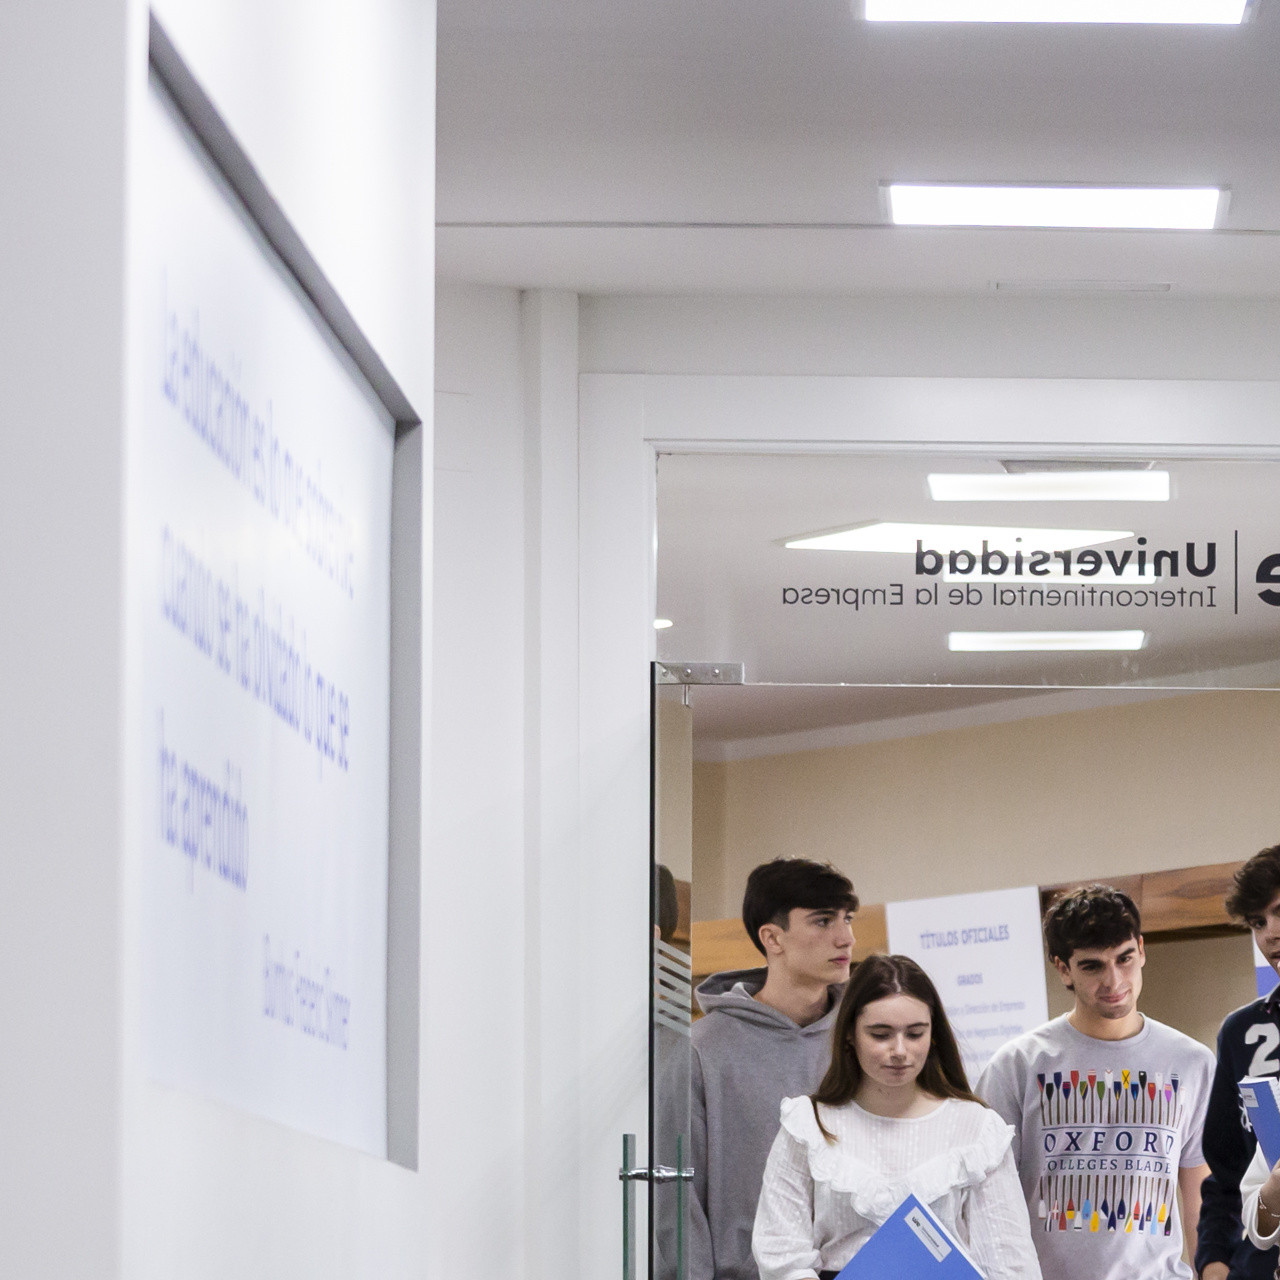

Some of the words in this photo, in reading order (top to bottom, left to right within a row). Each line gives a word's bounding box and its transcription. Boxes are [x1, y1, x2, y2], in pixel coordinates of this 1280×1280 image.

[962, 924, 1010, 944] OFICIALES
[1044, 1130, 1174, 1155] OXFORD
[1047, 1158, 1118, 1171] OLLEGES
[1125, 1159, 1172, 1174] BLADE
